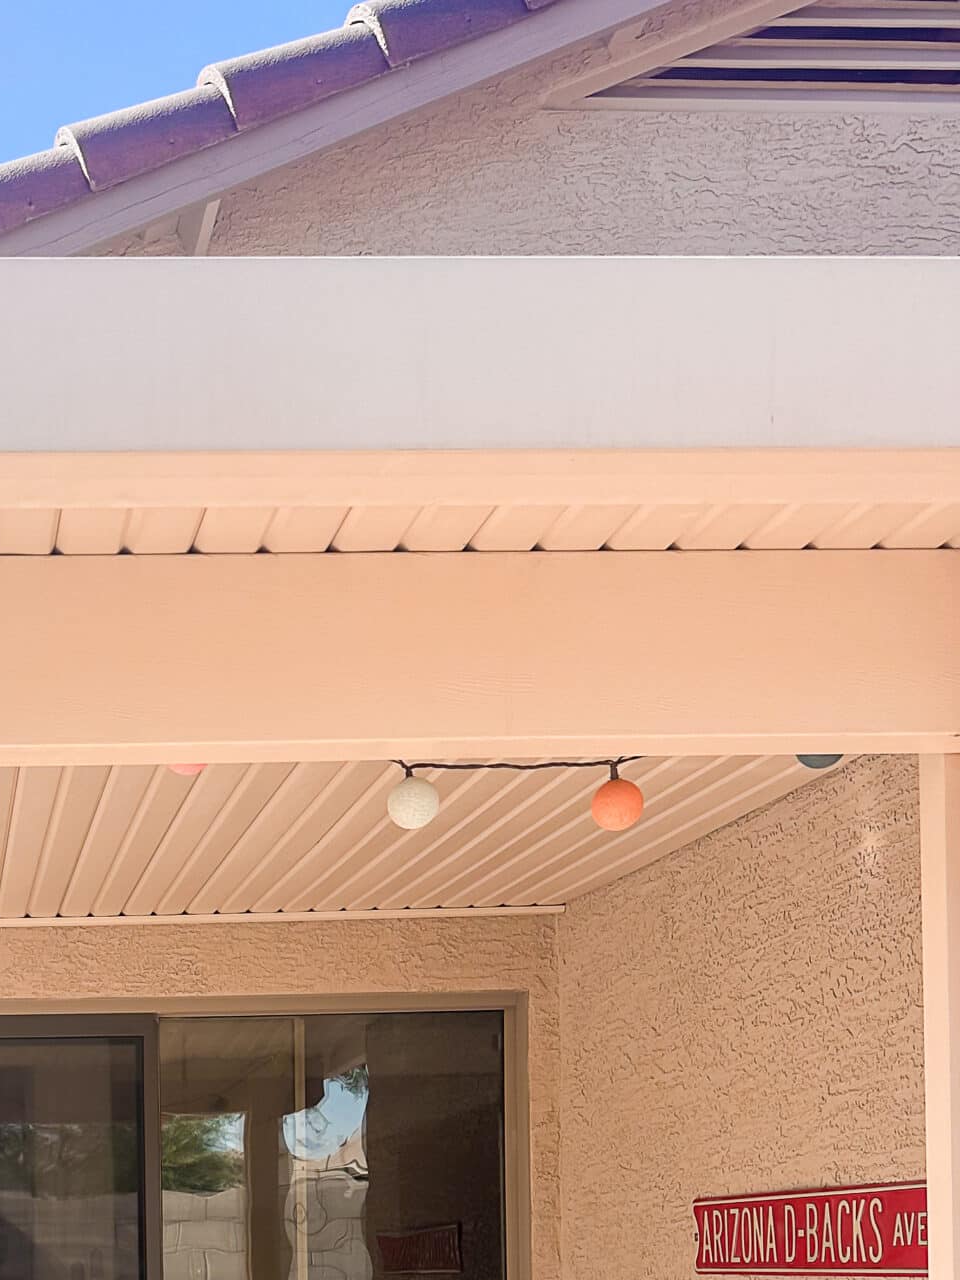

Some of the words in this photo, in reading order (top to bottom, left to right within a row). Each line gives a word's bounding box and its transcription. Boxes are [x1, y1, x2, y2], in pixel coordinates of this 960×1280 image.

[702, 1205, 777, 1263] ARIZONA
[784, 1198, 883, 1263] D-BACKS
[893, 1212, 928, 1246] AVE
